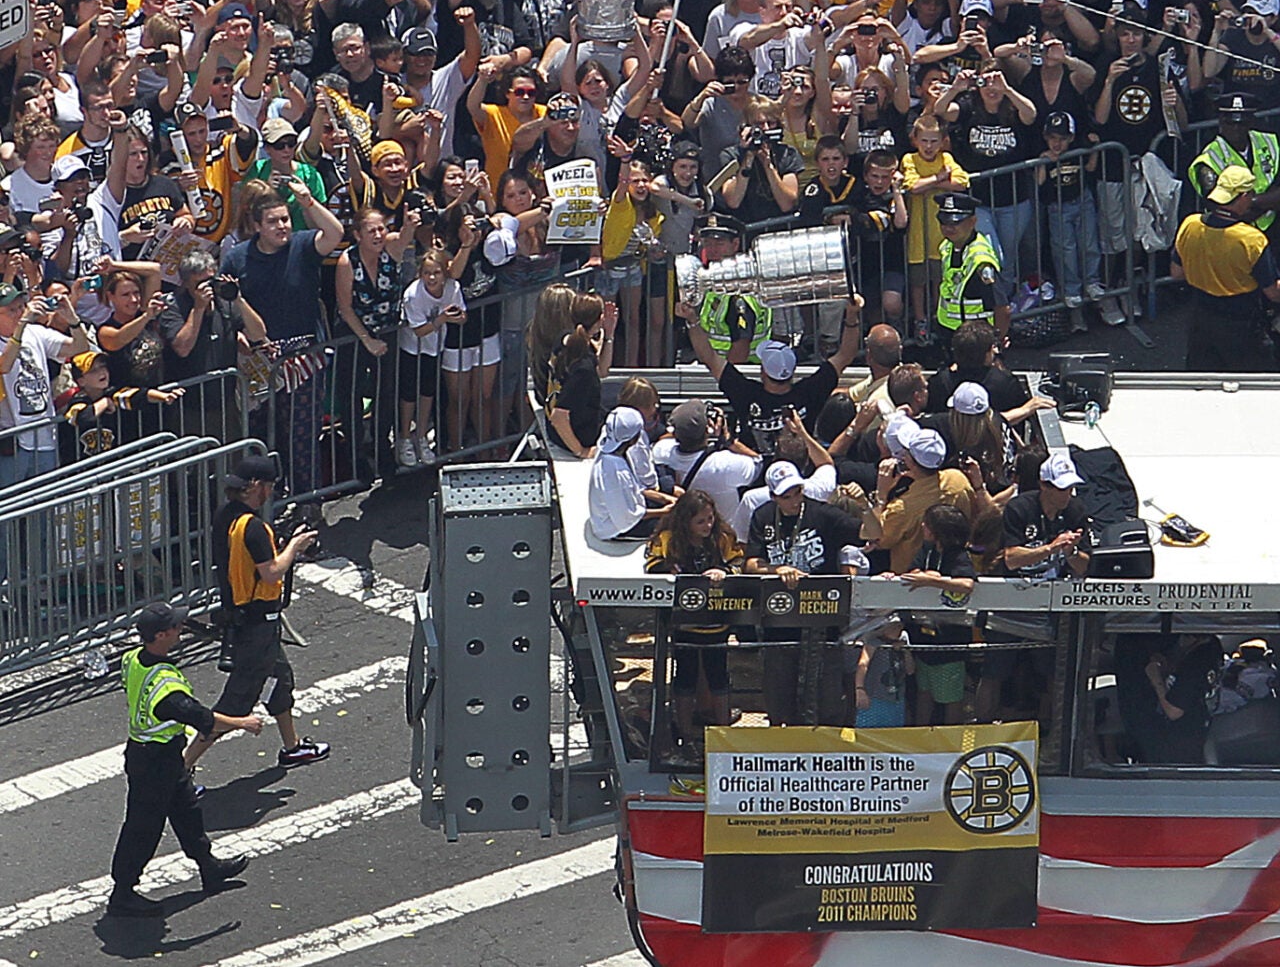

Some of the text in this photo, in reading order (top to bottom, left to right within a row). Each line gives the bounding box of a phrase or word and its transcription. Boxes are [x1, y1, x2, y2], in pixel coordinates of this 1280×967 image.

[551, 168, 585, 181] WEEI
[554, 188, 576, 197] WE
[567, 200, 592, 210] THE
[556, 212, 597, 229] CUP!
[1071, 583, 1143, 593] TICKETS &
[1157, 585, 1252, 599] PRUDENTIAL
[799, 591, 822, 600] MARK
[1061, 595, 1151, 606] DEPARTURES
[707, 599, 753, 611] SWEENEY
[799, 601, 838, 614] RECCHI
[1156, 601, 1252, 610] CENTER
[732, 756, 915, 772] Hallmark Health is the
[719, 776, 929, 792] Official Healthcare Partner
[738, 797, 755, 813] of
[759, 797, 784, 812] the
[789, 797, 844, 812] Boston
[830, 817, 871, 827] Hospital
[887, 815, 929, 824] Medford
[758, 827, 895, 837] Melrose-Wakefield Hospital
[805, 863, 933, 885] CONGRATULATIONS
[821, 886, 915, 904] BOSTON BRUINS
[818, 905, 917, 922] 2011 CHAMPIONS
